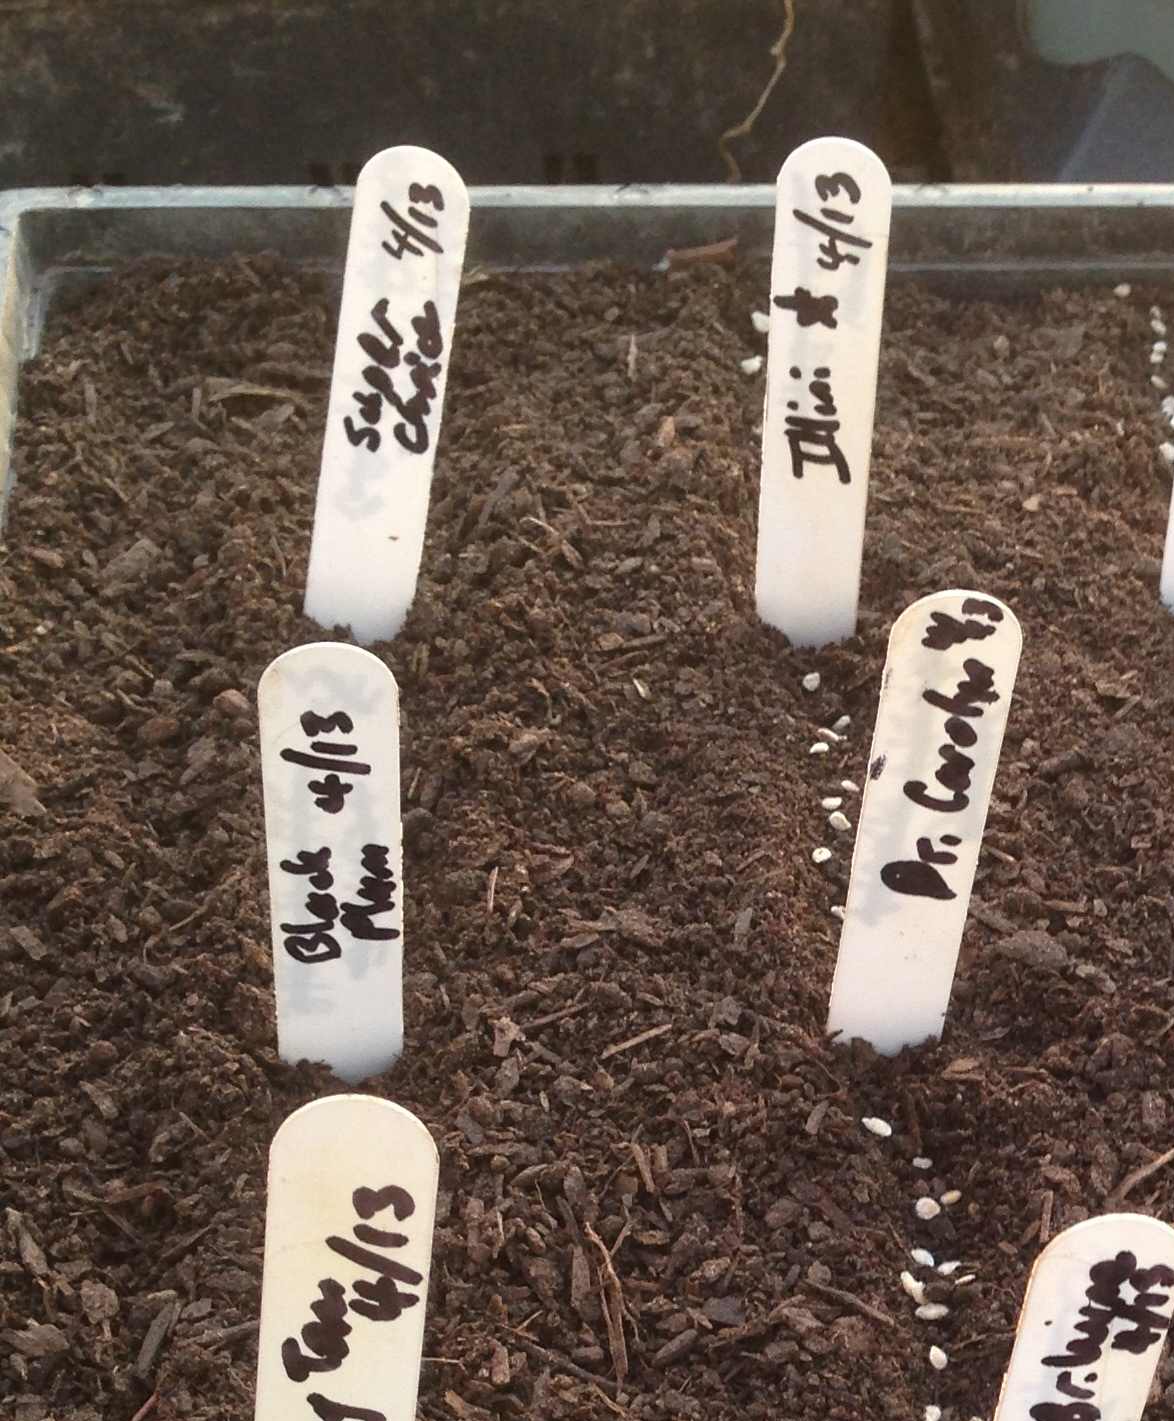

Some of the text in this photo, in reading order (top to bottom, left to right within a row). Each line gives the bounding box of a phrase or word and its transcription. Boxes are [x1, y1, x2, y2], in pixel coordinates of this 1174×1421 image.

[380, 182, 445, 260] 4/13
[792, 172, 873, 270] 4/13
[280, 711, 371, 964] Black 4/13
[880, 834, 962, 900] Dr.
[325, 1184, 424, 1321] 4/13
